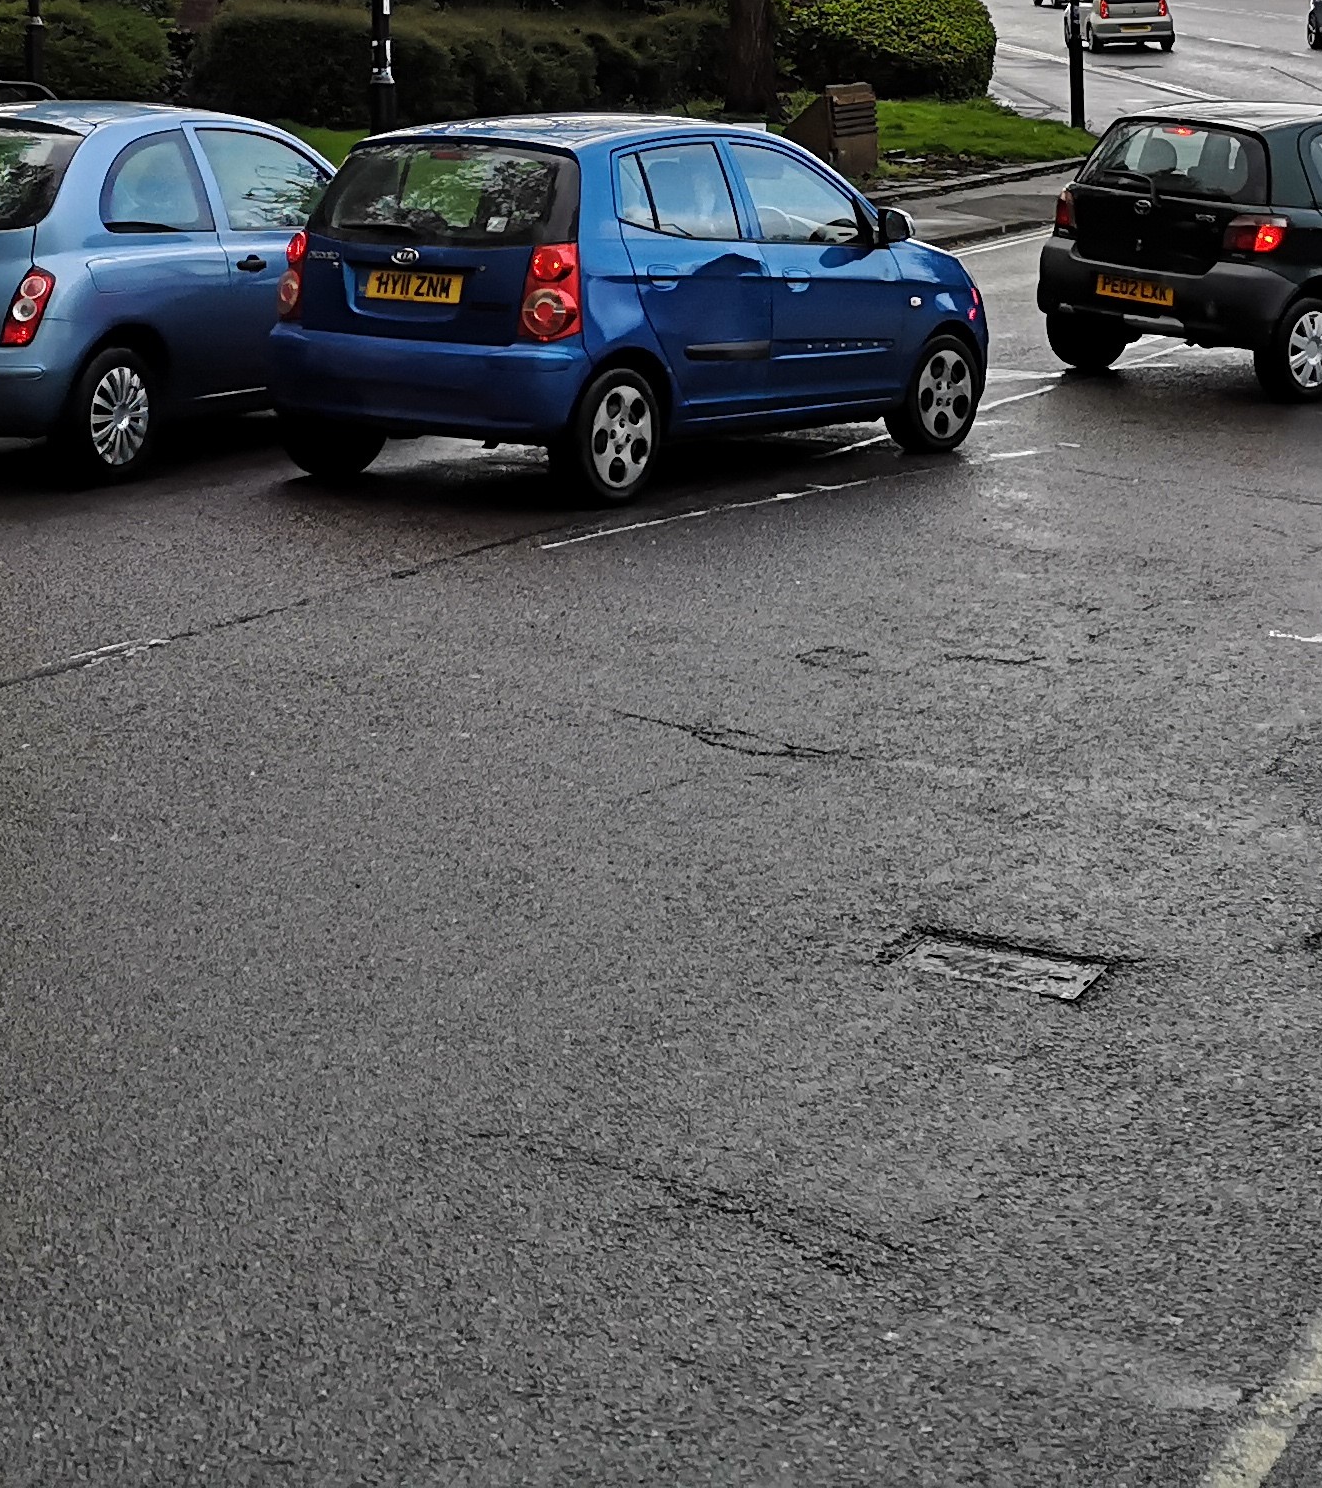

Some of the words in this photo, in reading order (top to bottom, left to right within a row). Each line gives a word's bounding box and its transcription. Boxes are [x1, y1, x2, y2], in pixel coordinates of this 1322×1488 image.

[396, 252, 413, 261] KIA
[376, 272, 412, 296] HY11
[413, 275, 452, 299] ZNM
[1101, 276, 1138, 297] PE02
